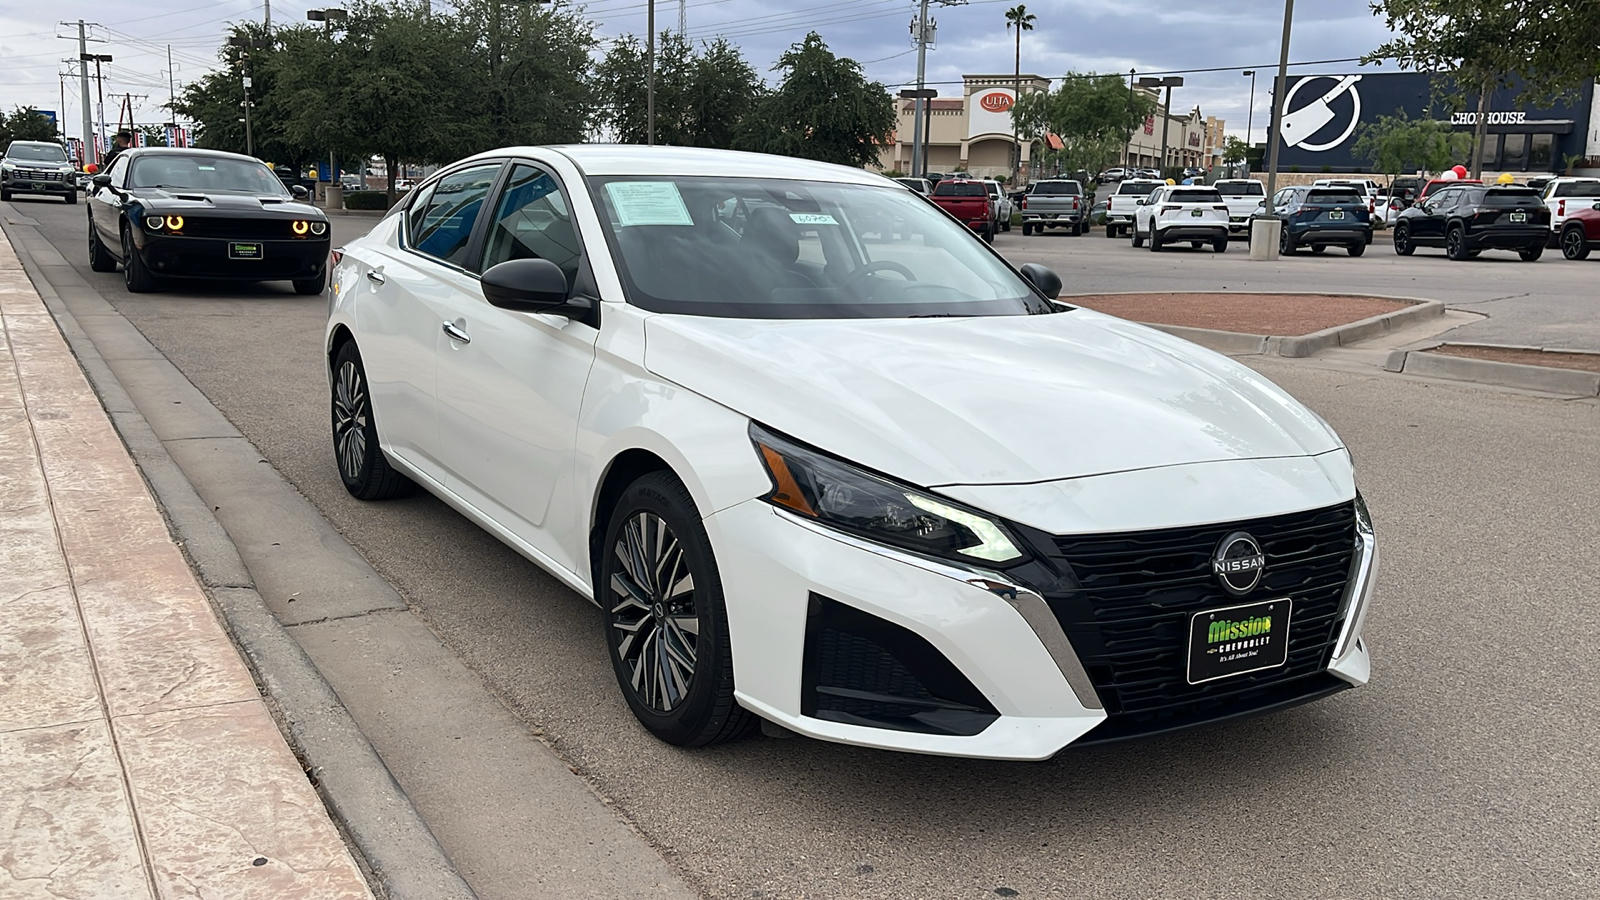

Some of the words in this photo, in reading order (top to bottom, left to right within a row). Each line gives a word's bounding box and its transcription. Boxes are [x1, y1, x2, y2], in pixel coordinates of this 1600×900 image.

[986, 96, 1010, 105] ULTA
[1214, 555, 1265, 572] NISSAN
[1208, 616, 1271, 644] Mission
[1219, 636, 1270, 653] CHEVROLET
